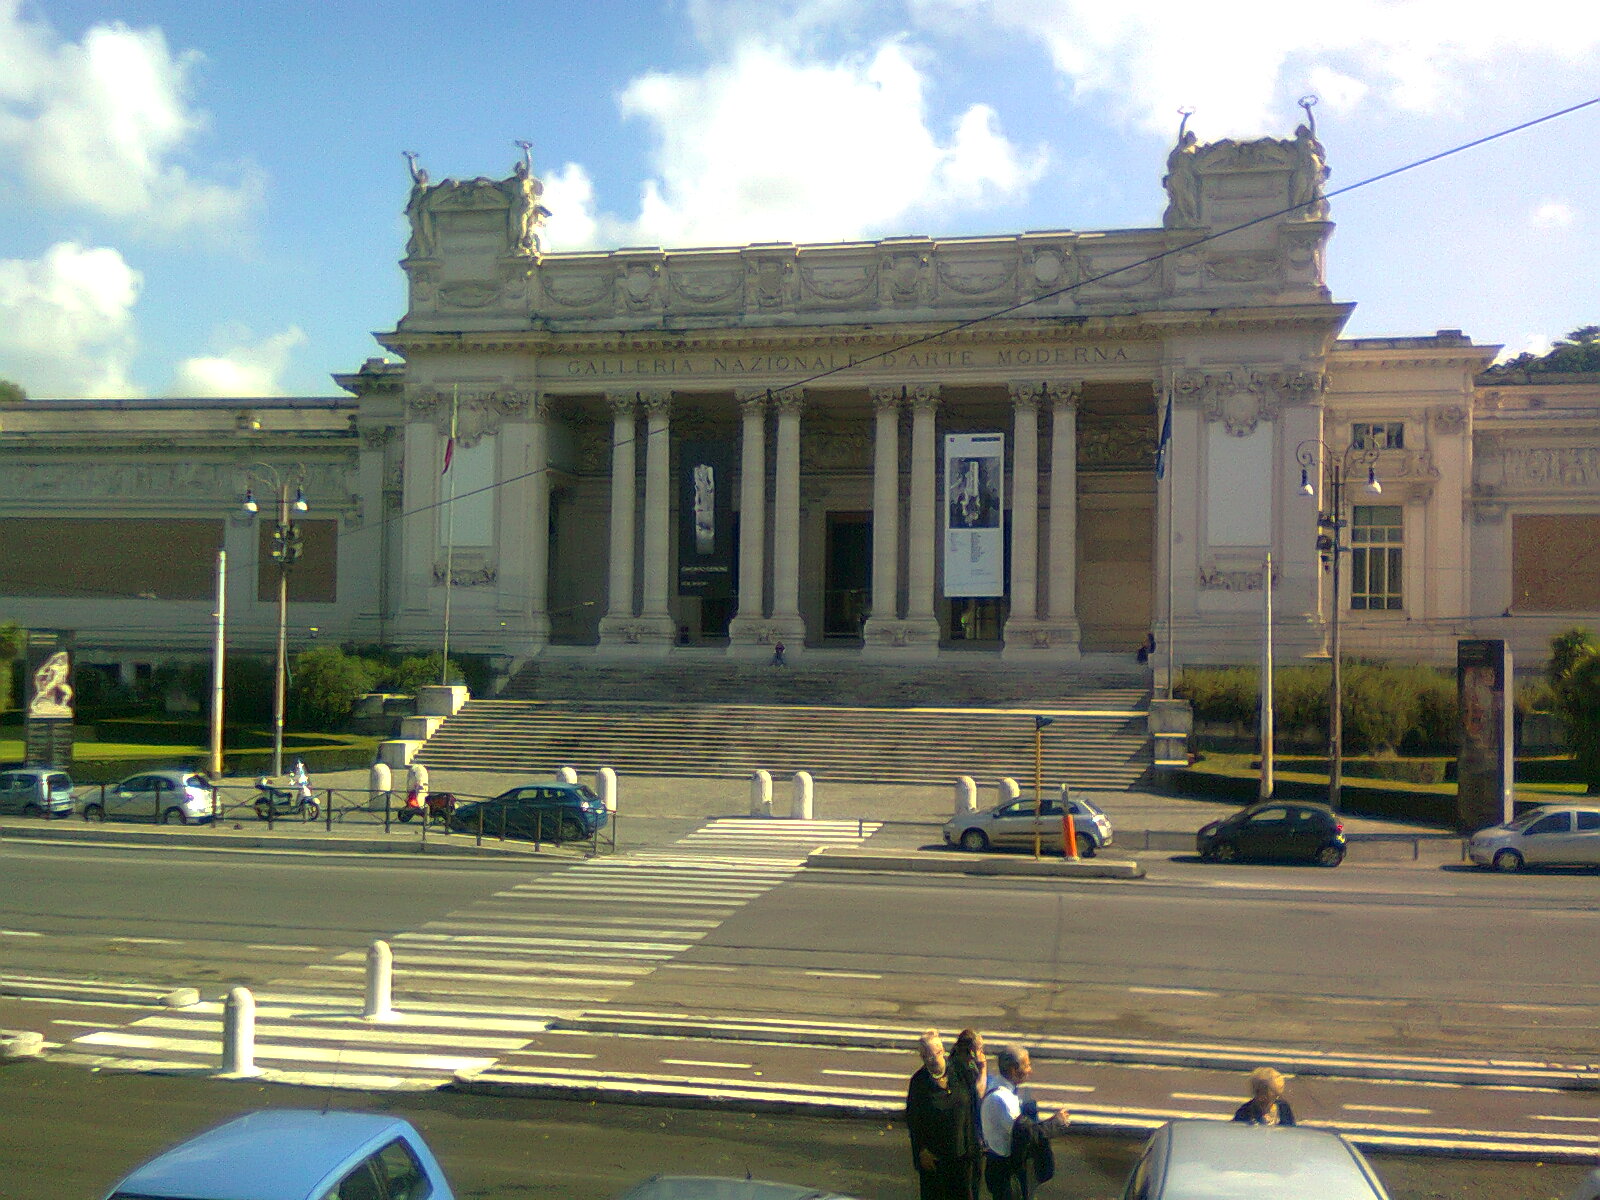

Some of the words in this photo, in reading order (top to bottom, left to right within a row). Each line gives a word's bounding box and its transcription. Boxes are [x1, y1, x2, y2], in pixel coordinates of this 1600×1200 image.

[567, 358, 693, 376] GALLERIA
[713, 354, 860, 373] NAZIONALE
[882, 350, 973, 368] D'ARTE
[999, 347, 1129, 366] MODERNA
